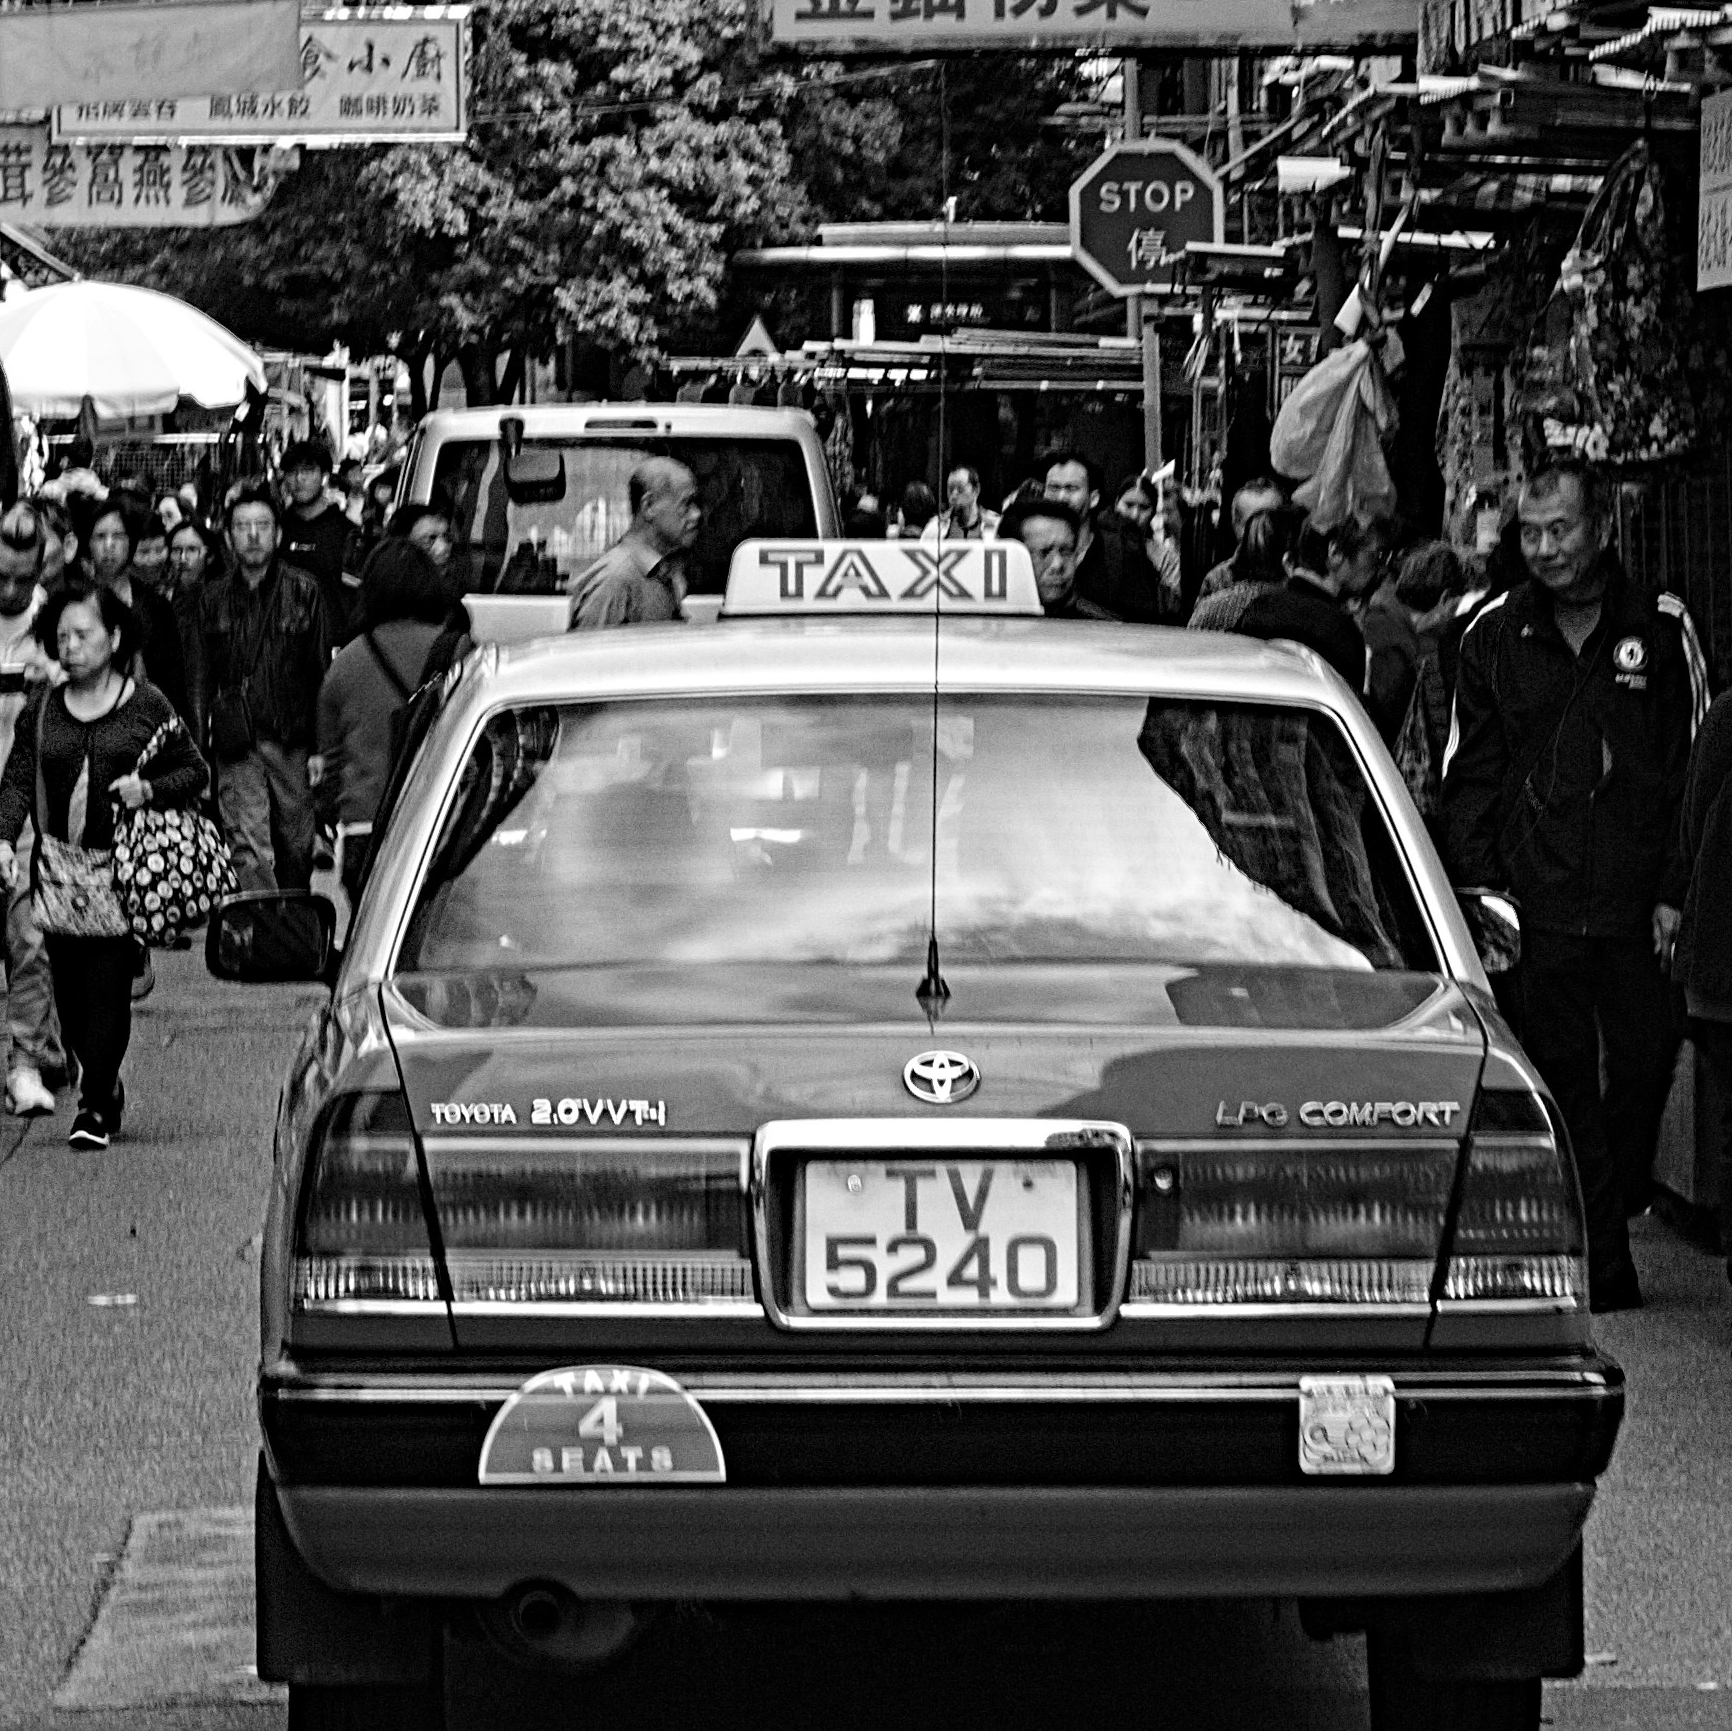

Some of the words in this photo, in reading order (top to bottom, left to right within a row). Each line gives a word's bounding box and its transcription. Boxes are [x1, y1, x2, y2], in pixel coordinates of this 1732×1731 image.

[1099, 179, 1195, 213] STOP
[1127, 226, 1167, 270] 停
[758, 548, 1008, 602] TAXI
[430, 1102, 517, 1125] TOYOTA
[1298, 1100, 1462, 1127] COMFORT
[885, 1168, 995, 1235] TV
[825, 1234, 1059, 1301] 5240
[553, 1368, 652, 1400] TAXI
[578, 1395, 624, 1447] 4
[531, 1444, 674, 1474] SEATS
